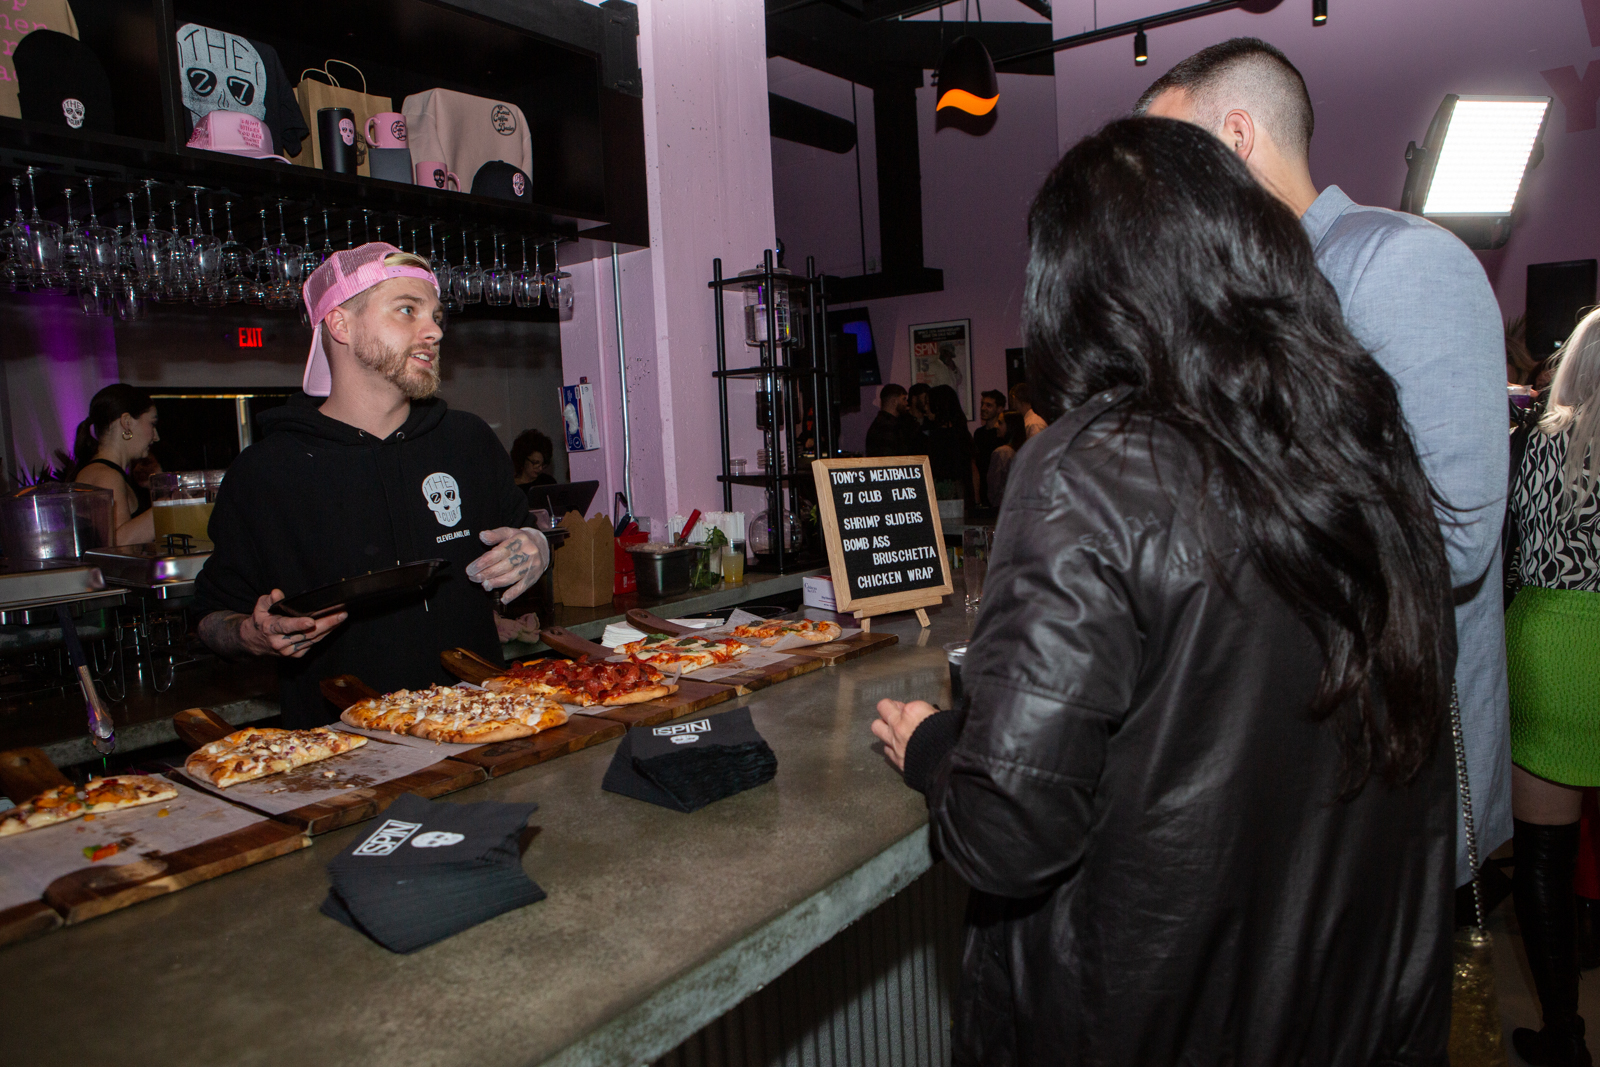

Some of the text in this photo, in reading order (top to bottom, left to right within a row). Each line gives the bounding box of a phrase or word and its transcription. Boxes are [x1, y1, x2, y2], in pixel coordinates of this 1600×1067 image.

[183, 27, 252, 76] THE
[238, 327, 263, 348] EXIT
[915, 343, 938, 356] SPIN
[425, 475, 453, 491] THE
[831, 467, 922, 485] TONY'S MEATBALLS
[842, 487, 917, 505] 27 CLUB FLATS
[843, 511, 924, 530] SHRIMP SLIDERS
[843, 535, 891, 552] BOMB ASS
[872, 546, 937, 566] BRUSCHETTA
[857, 566, 935, 589] CHICKEN WRAP
[656, 720, 708, 735] SPIN
[359, 821, 418, 854] SPIN
